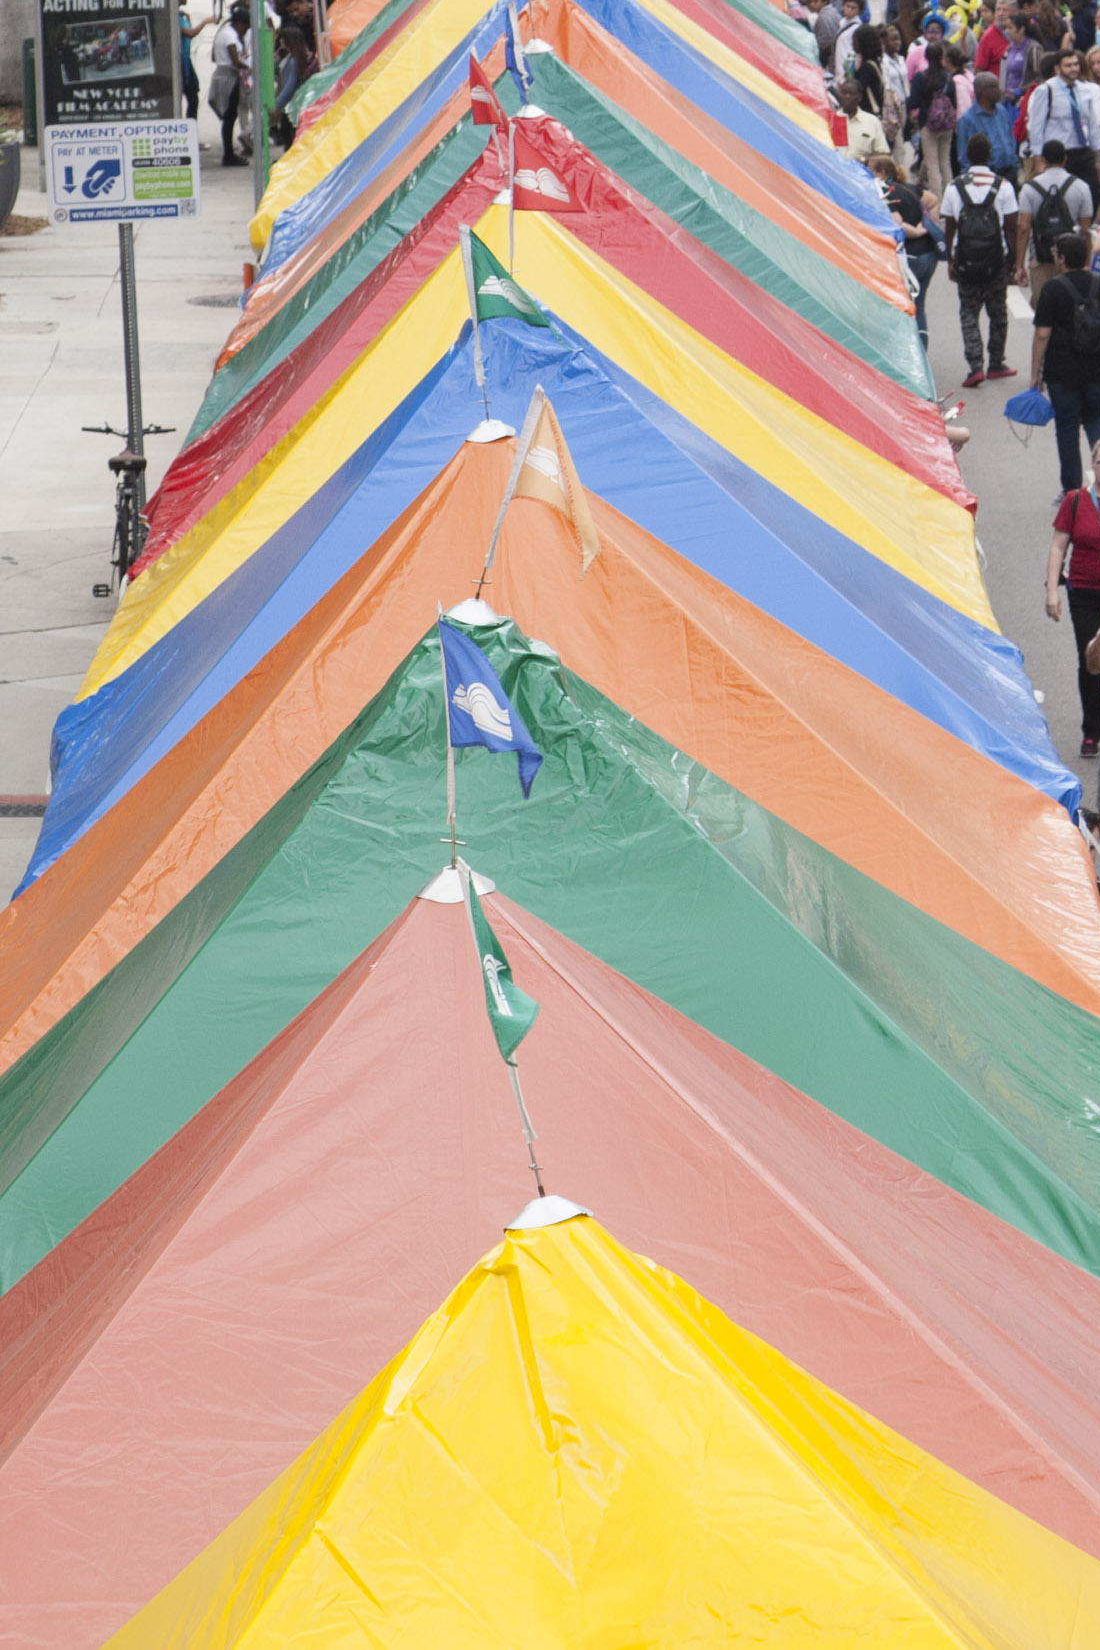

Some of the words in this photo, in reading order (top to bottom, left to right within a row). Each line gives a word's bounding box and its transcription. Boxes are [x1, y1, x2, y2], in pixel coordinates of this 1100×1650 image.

[73, 88, 102, 99] NEW
[57, 102, 90, 112] FILM
[51, 127, 117, 139] PAYMENT
[124, 124, 188, 136] OPTIONS
[57, 148, 72, 157] PAY
[76, 147, 86, 155] AT
[88, 145, 118, 155] METER
[154, 145, 190, 155] phone
[71, 206, 177, 219] www.miamiparking.com
